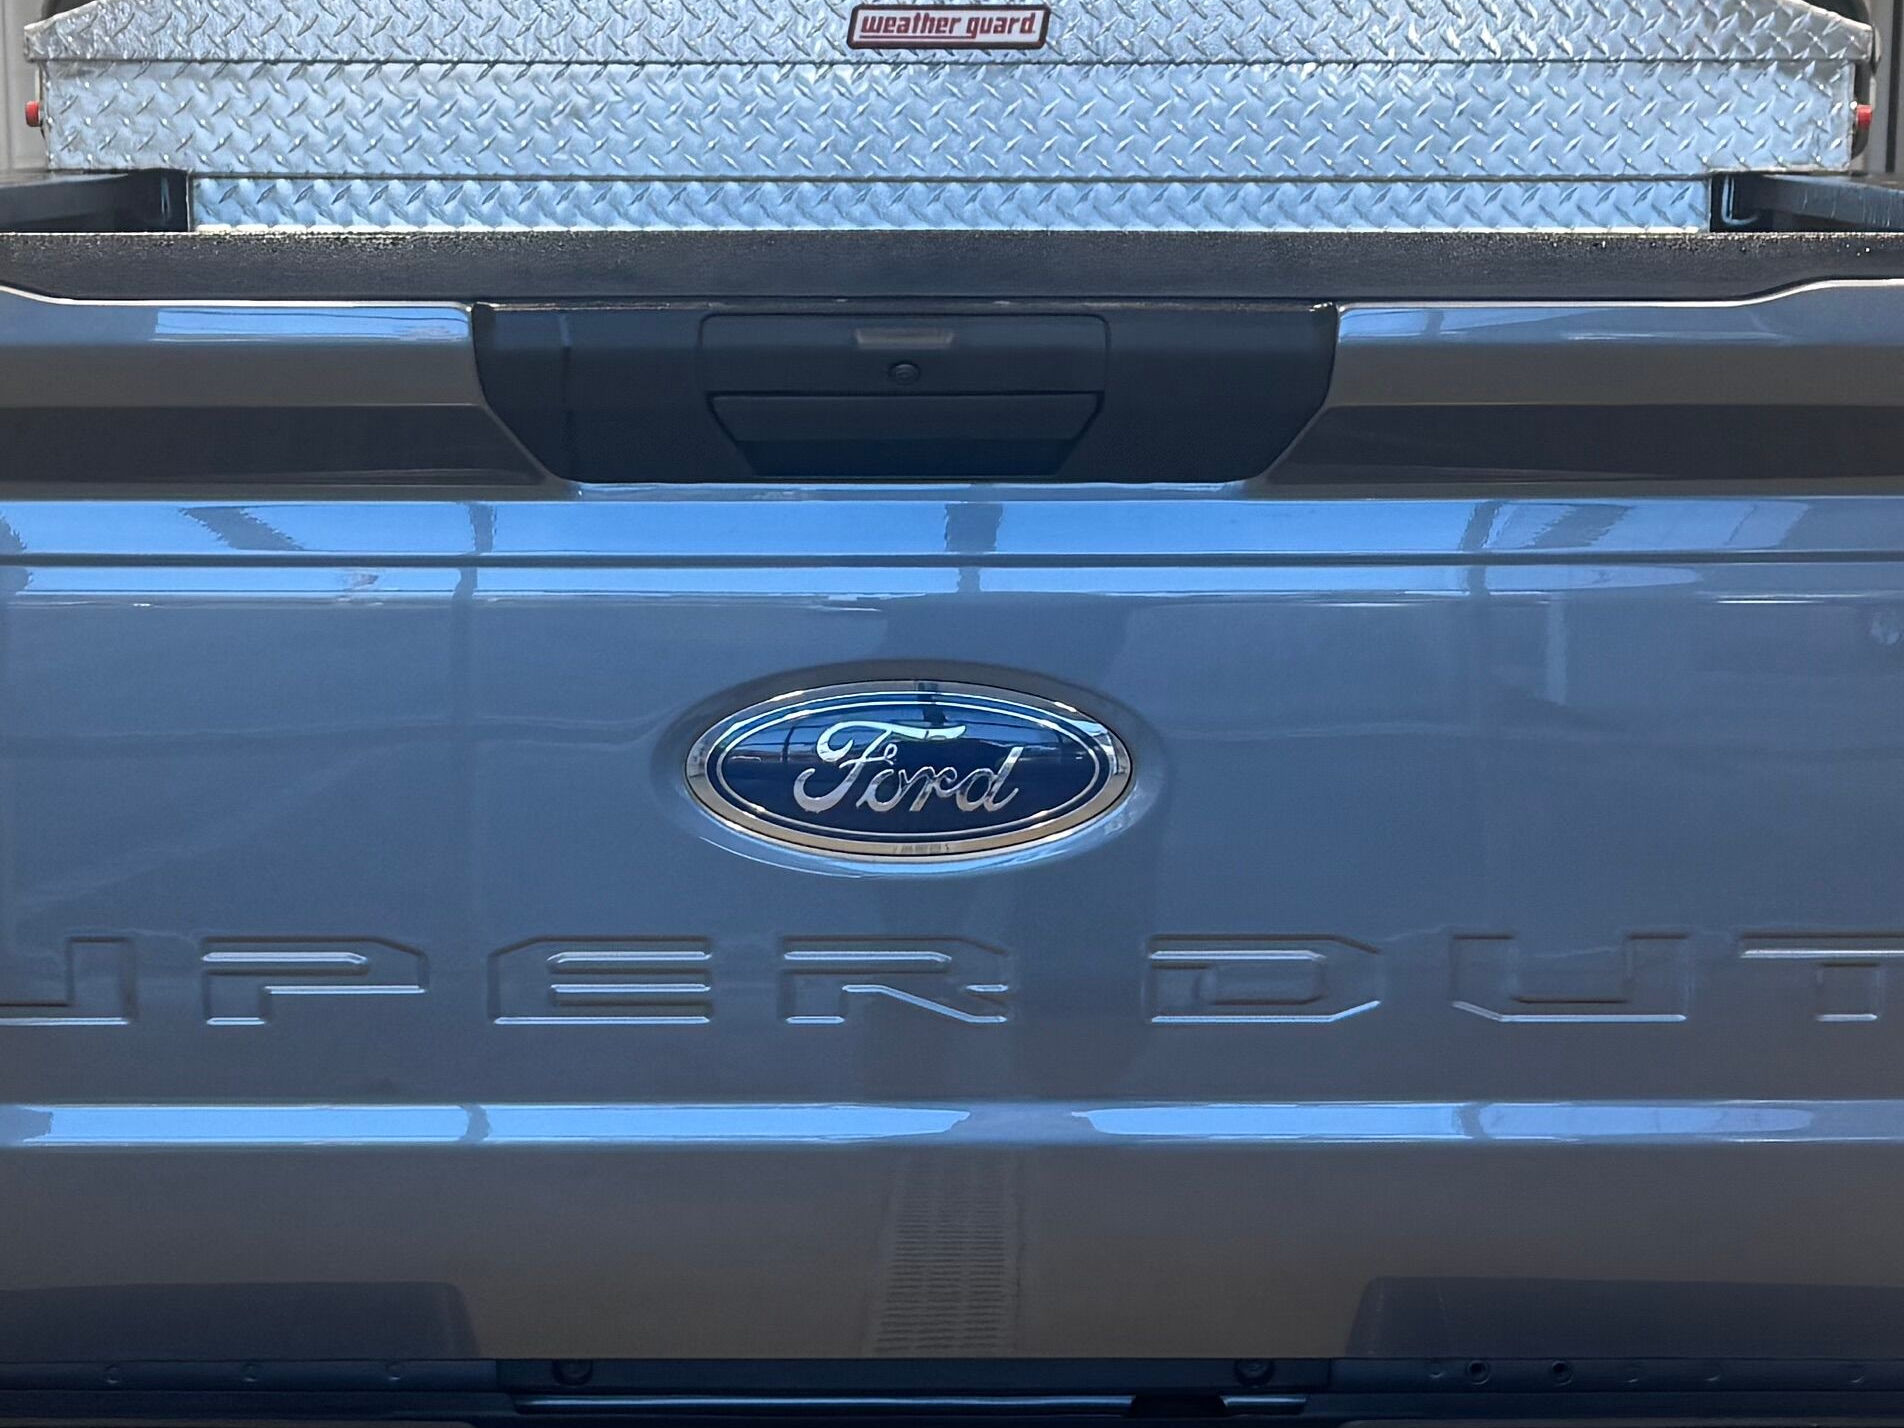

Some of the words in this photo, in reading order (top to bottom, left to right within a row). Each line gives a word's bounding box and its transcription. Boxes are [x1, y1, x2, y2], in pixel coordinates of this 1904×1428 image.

[861, 12, 961, 35] weather
[966, 12, 1036, 39] guard
[793, 720, 1022, 813] Ford
